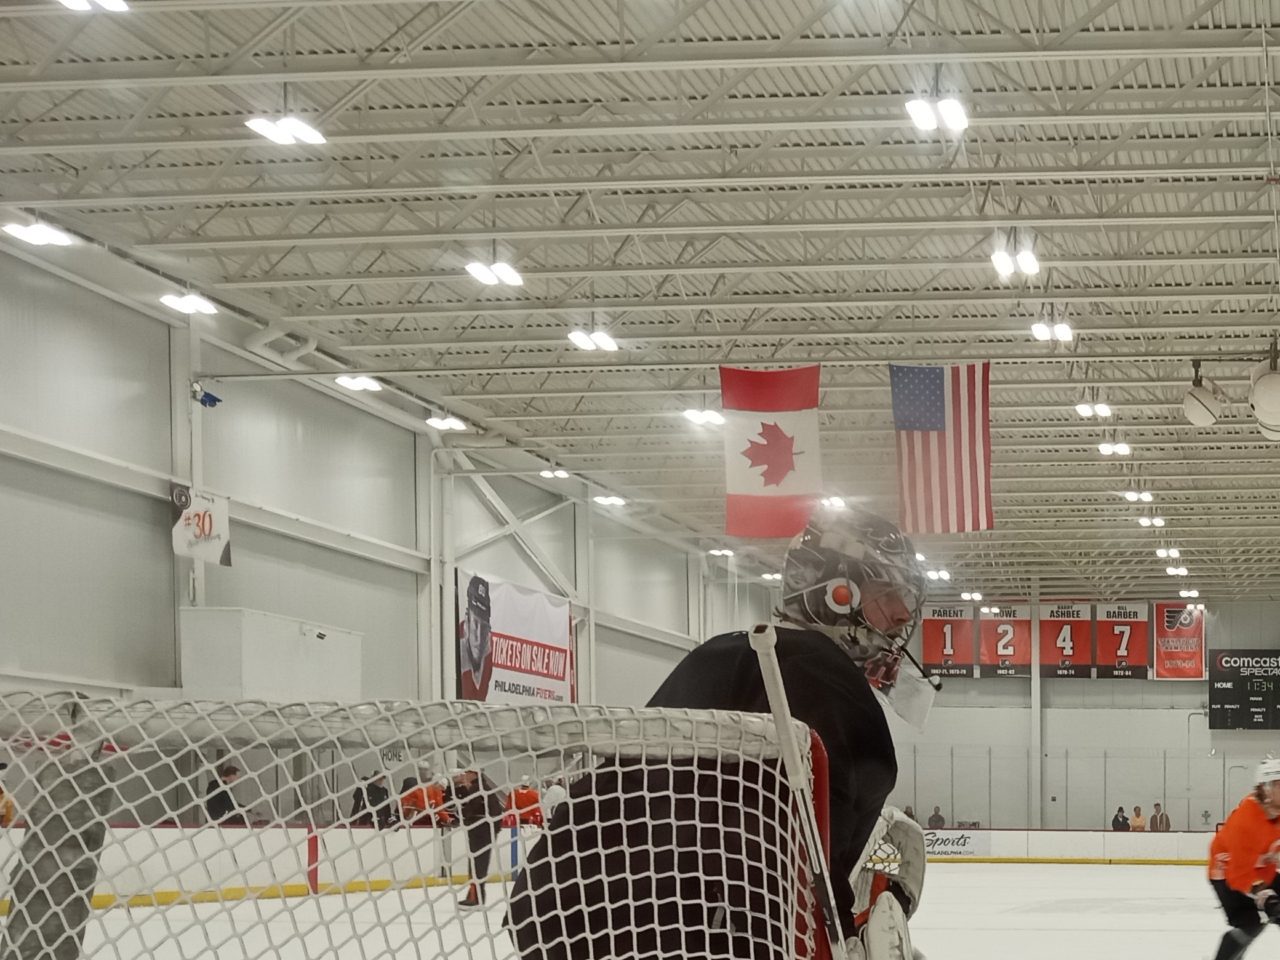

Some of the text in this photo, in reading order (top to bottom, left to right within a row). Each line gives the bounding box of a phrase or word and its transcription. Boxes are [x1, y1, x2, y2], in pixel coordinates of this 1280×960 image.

[932, 609, 964, 618] PARENT
[1049, 610, 1081, 619] ASHBEE
[1106, 611, 1138, 619] BARBER
[943, 624, 954, 655] 1
[997, 624, 1014, 656] 2
[1056, 624, 1073, 656] 4
[1113, 625, 1131, 656] 7
[492, 636, 566, 678] TICKETS ON SALE NOW
[924, 832, 971, 849] Sports
